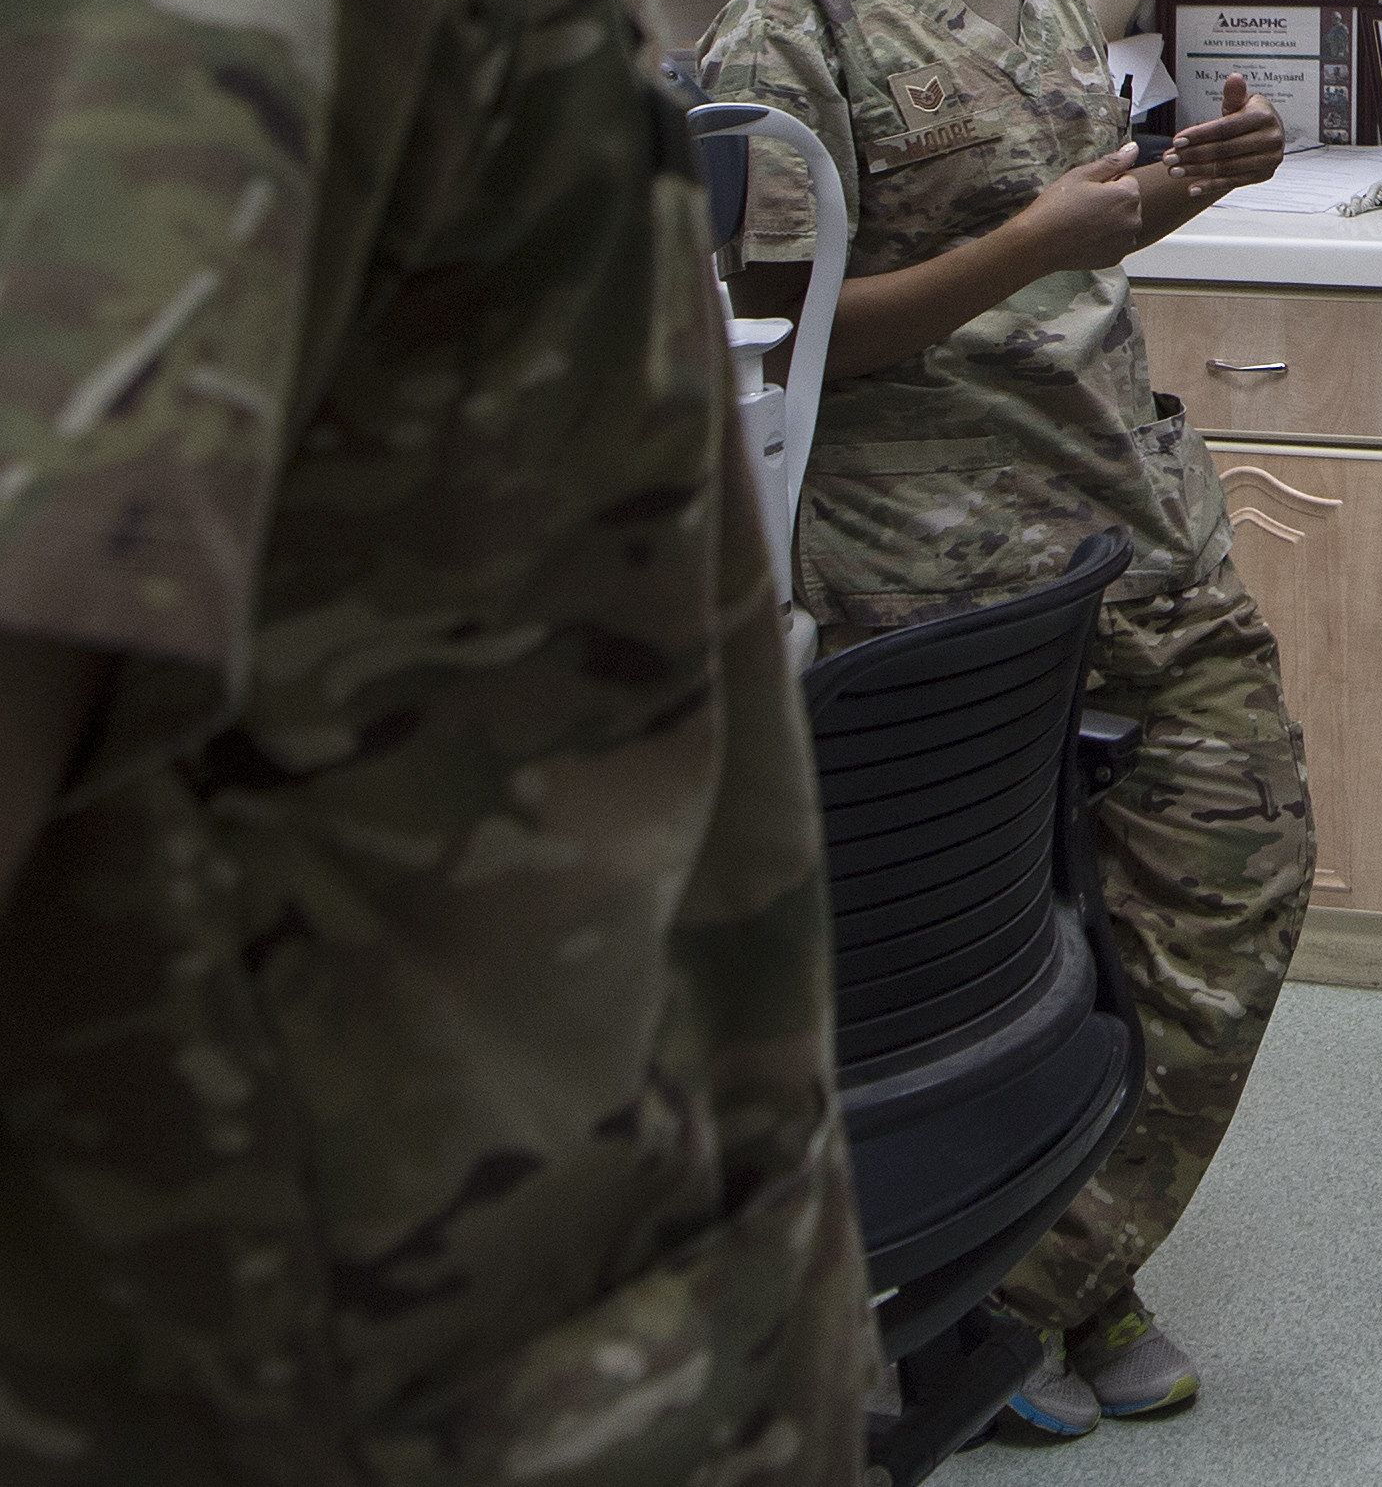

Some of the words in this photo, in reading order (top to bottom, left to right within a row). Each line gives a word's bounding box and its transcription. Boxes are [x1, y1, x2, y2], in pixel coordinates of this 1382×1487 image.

[1230, 17, 1288, 28] USAPHC
[1195, 70, 1212, 80] Ms.
[1263, 73, 1305, 83] Maynard
[904, 118, 976, 158] MOORE
